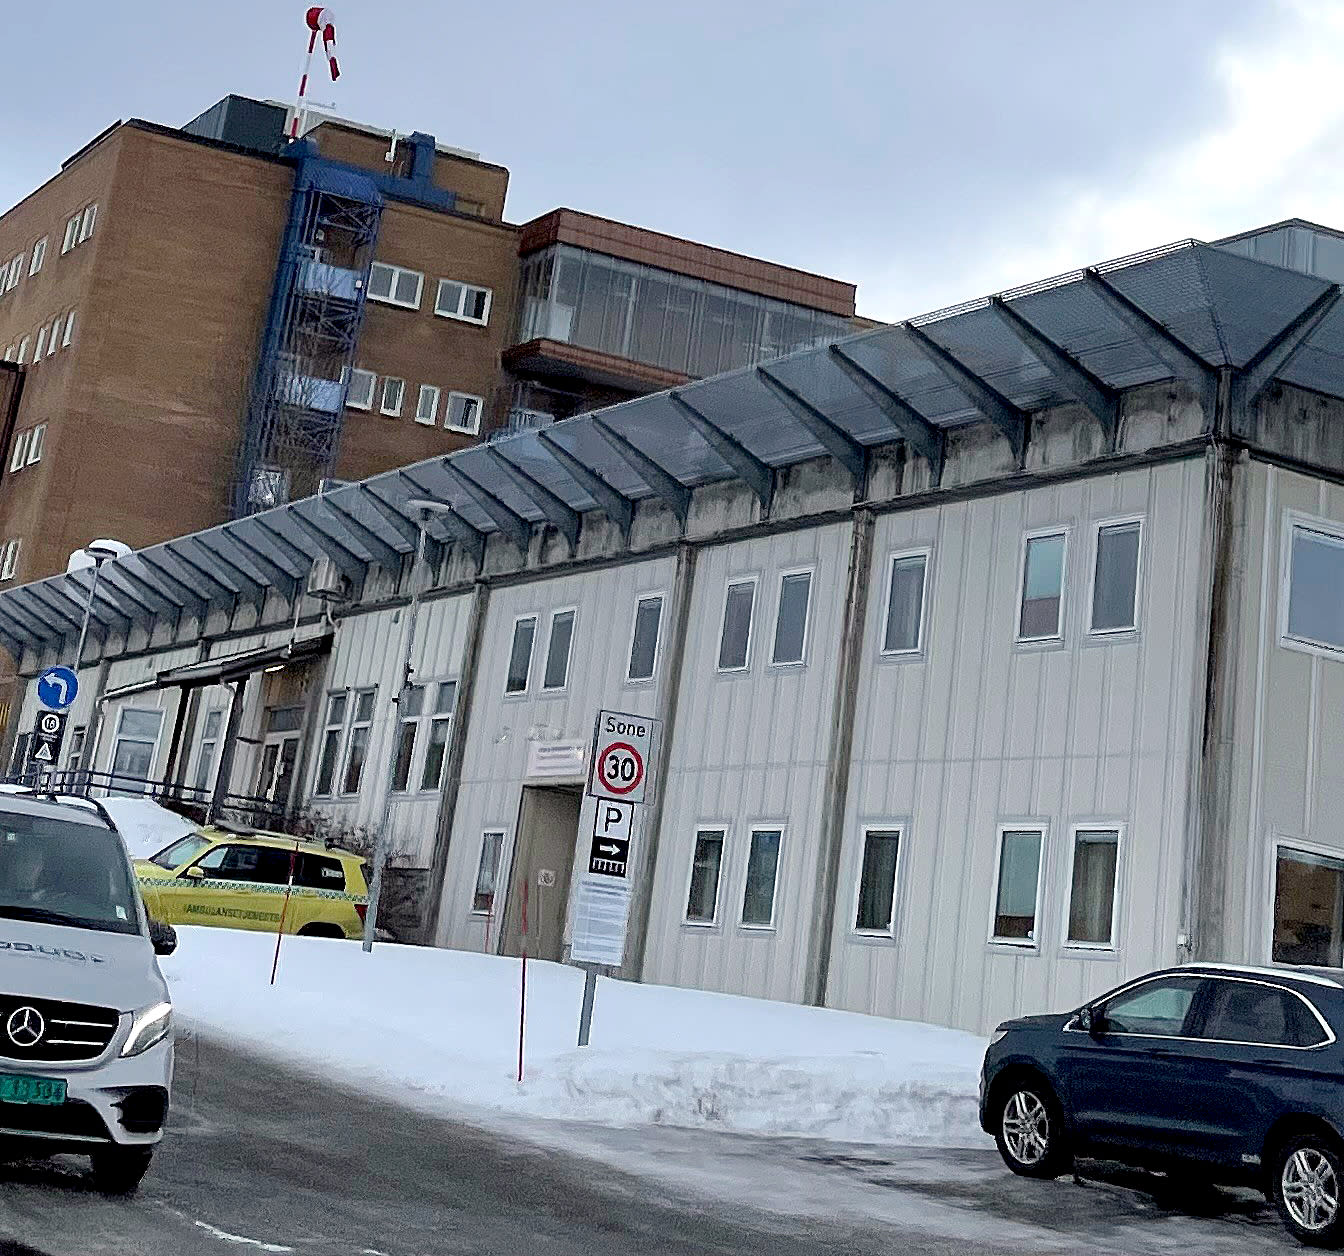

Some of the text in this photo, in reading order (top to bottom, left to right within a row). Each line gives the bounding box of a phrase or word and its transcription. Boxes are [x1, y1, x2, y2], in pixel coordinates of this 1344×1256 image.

[46, 718, 56, 729] 16
[606, 716, 646, 738] Sone
[606, 754, 635, 782] 30
[604, 806, 623, 832] P
